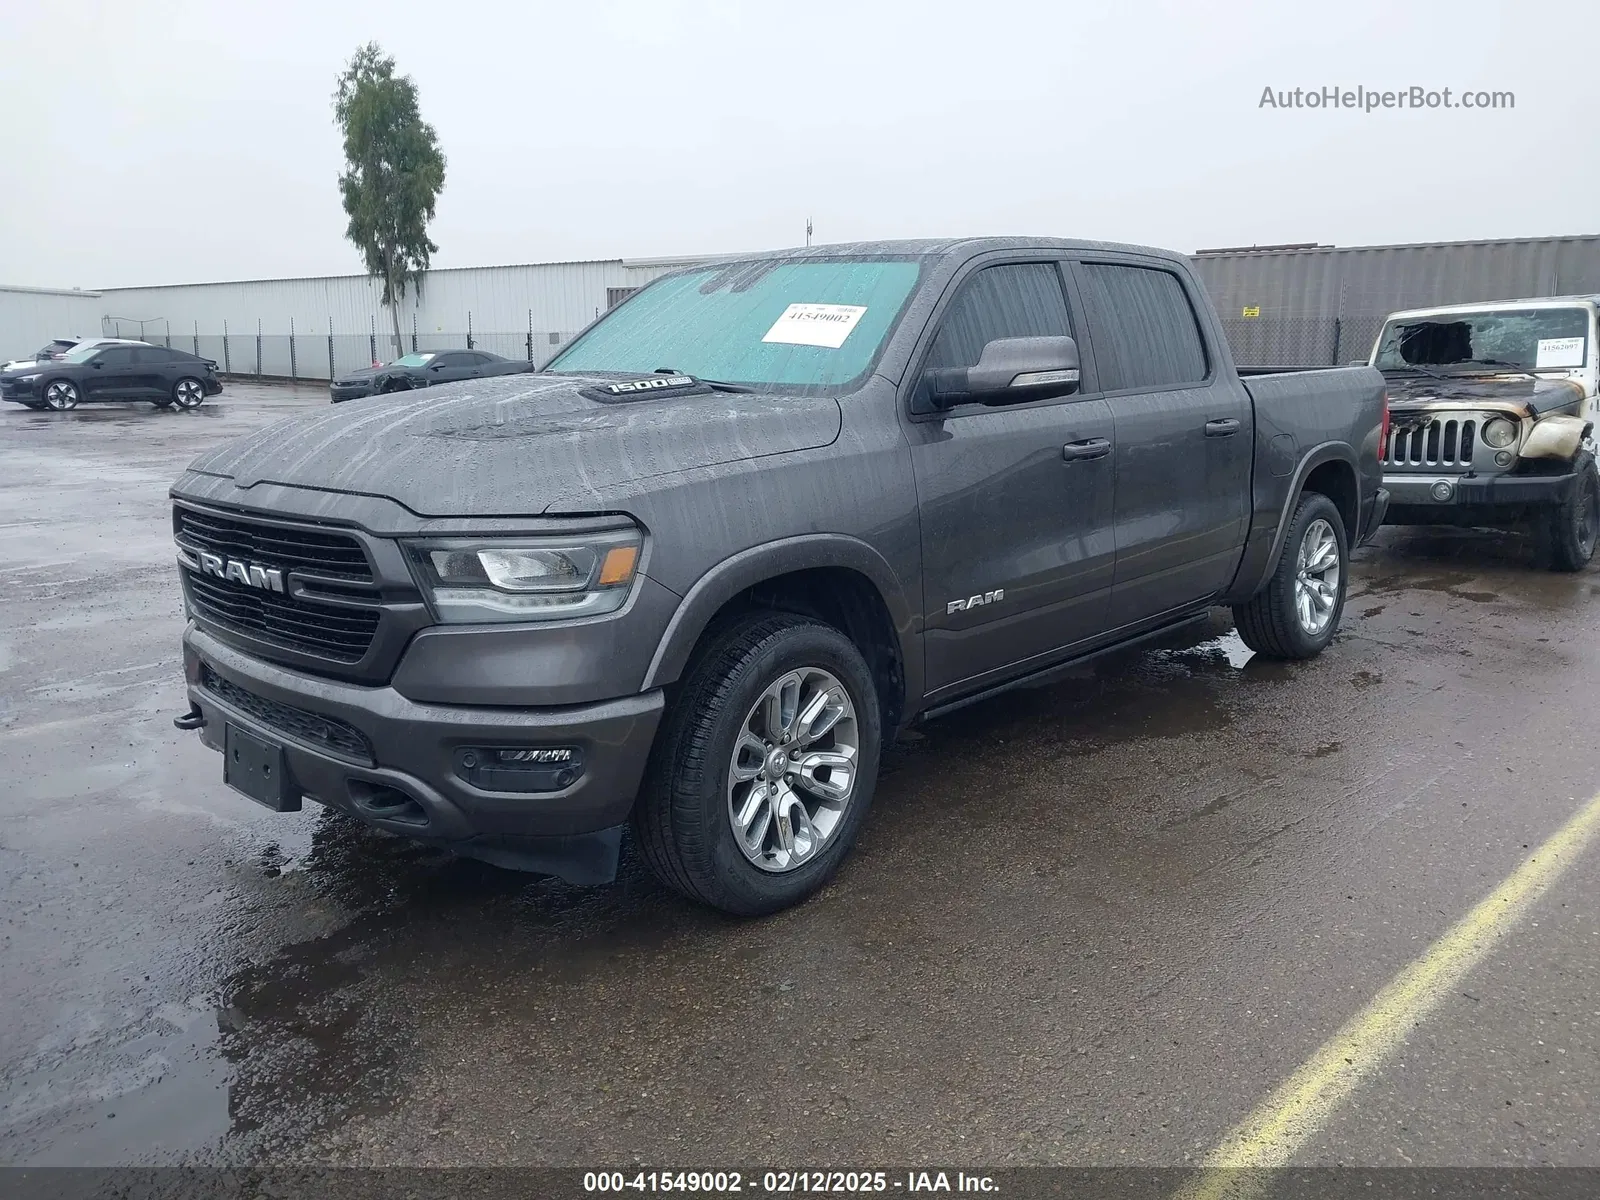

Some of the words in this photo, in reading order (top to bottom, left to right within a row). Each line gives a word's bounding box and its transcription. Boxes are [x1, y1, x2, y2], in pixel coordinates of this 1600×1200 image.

[788, 311, 850, 323] 41549002
[1542, 343, 1578, 351] 41562097
[608, 379, 669, 393] 1500
[201, 552, 284, 594] RAM
[946, 588, 1004, 615] RAM
